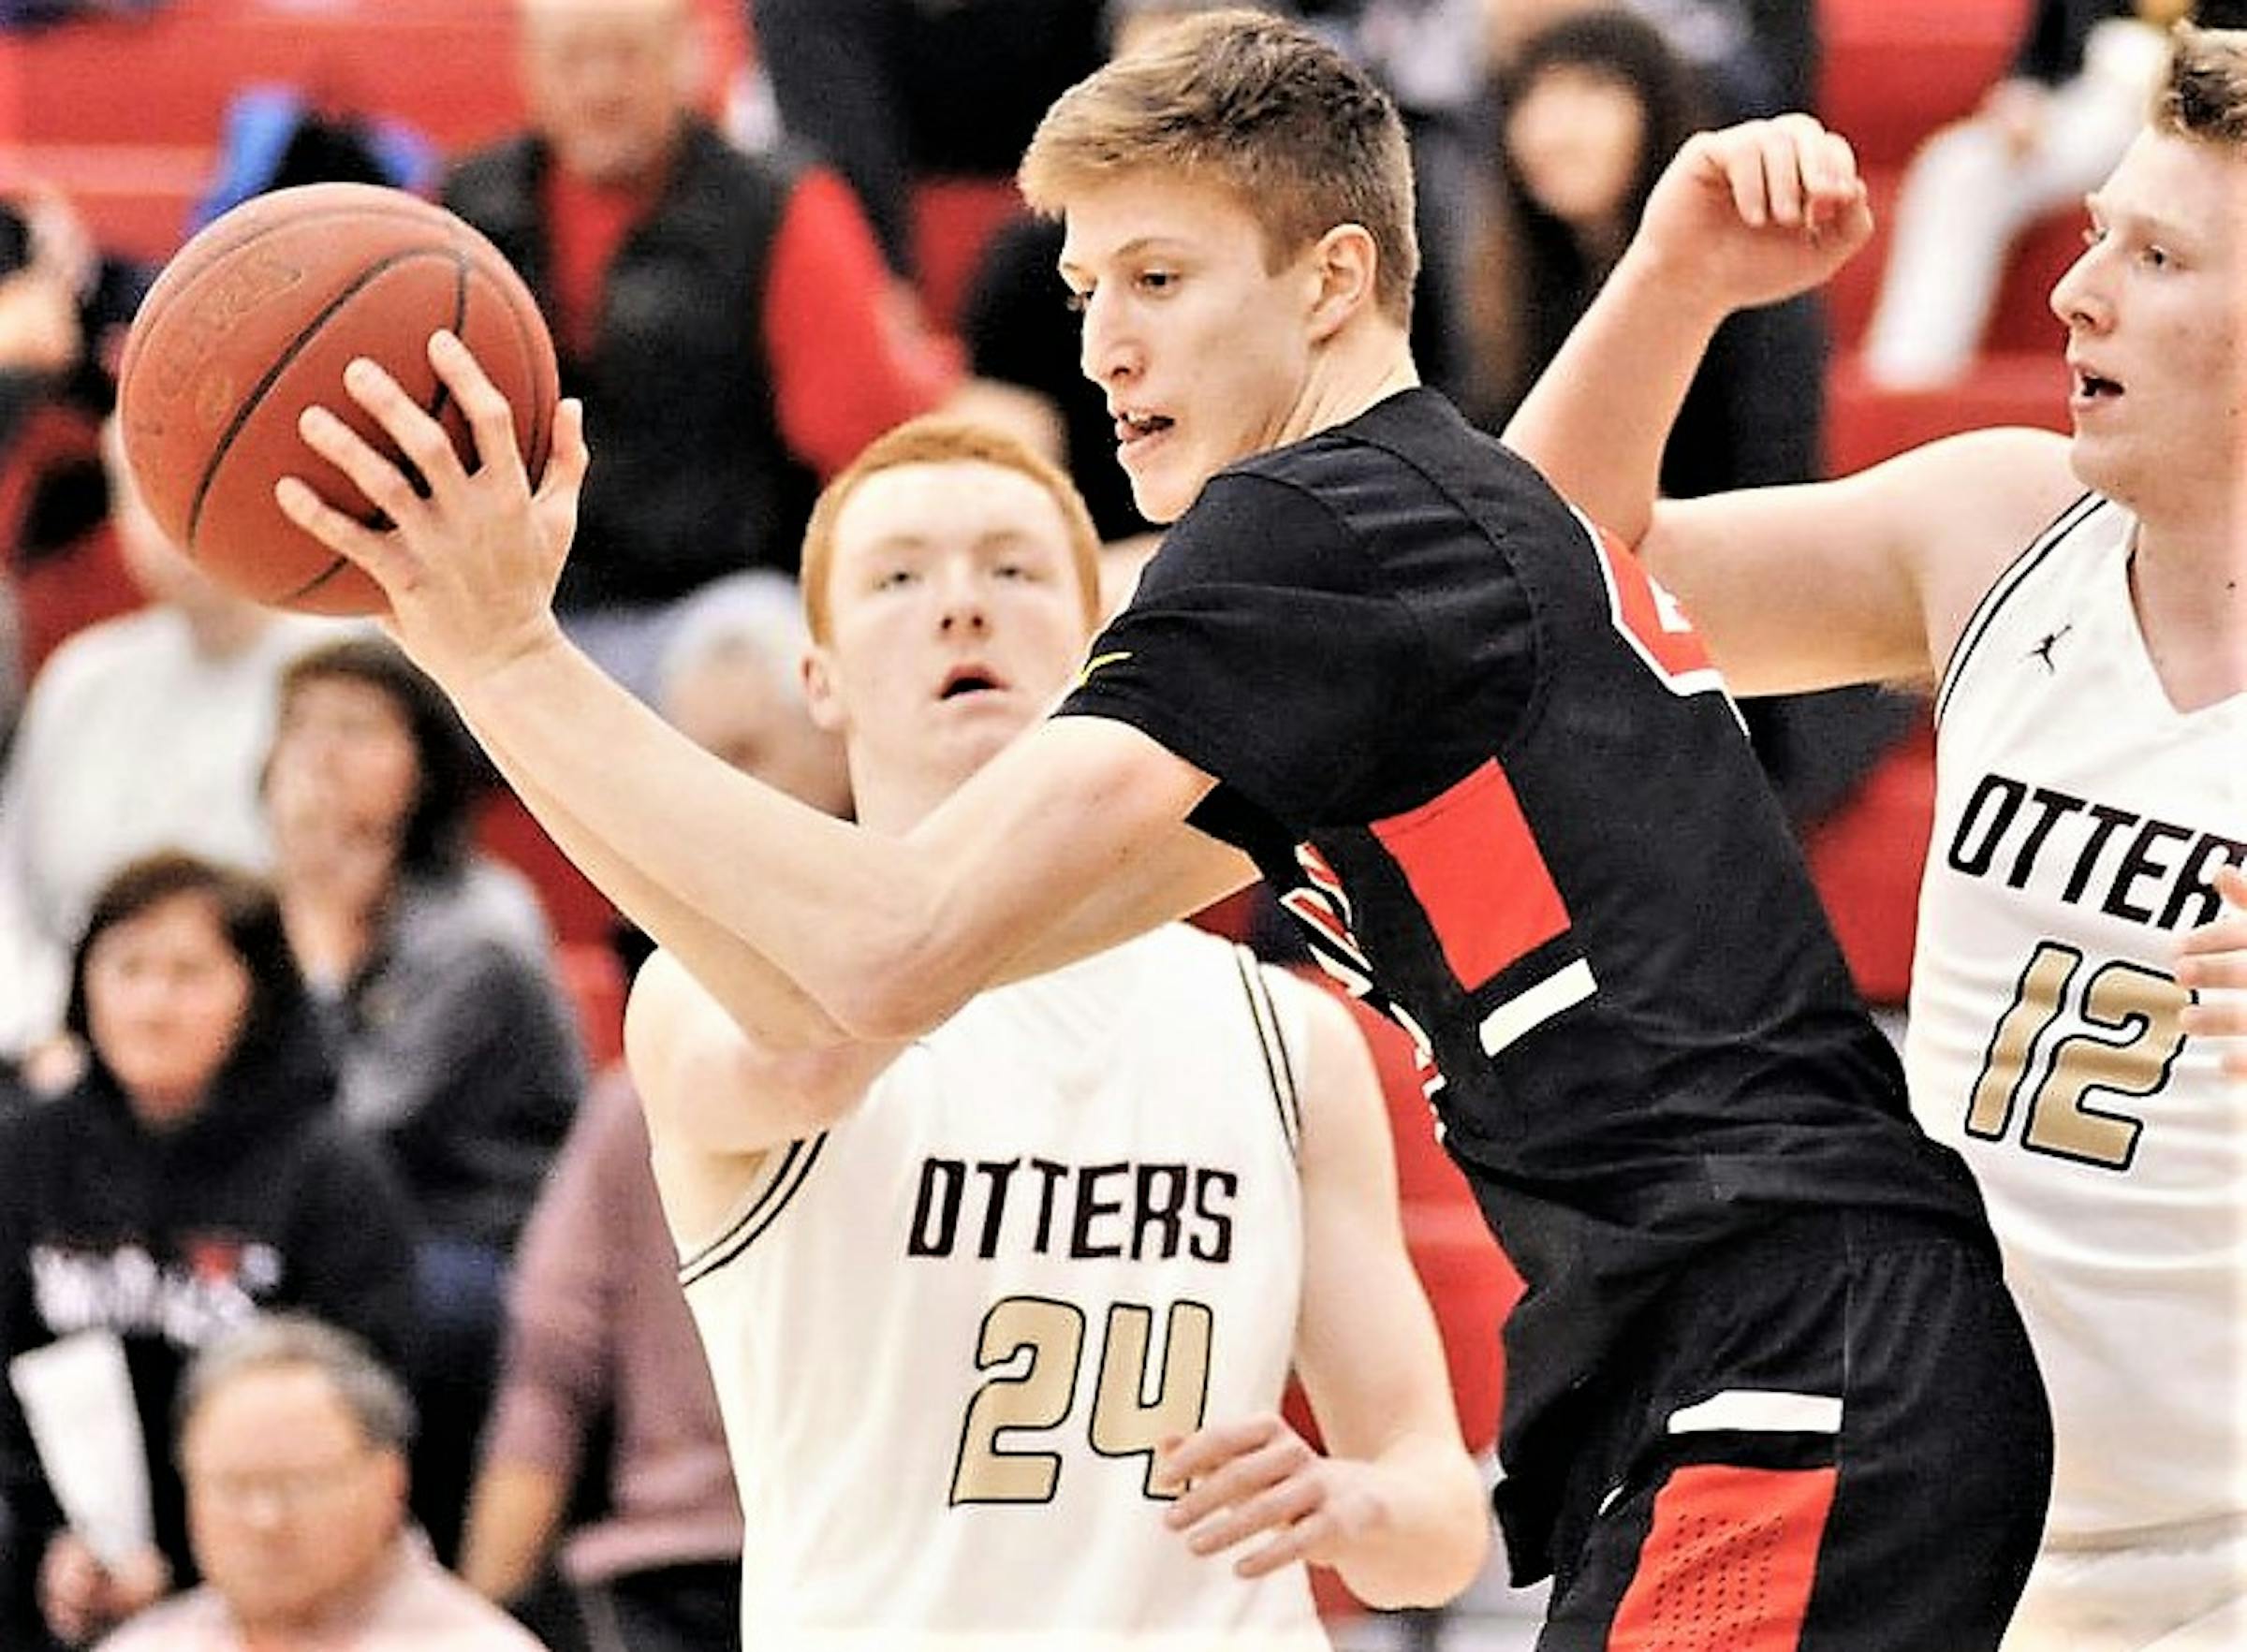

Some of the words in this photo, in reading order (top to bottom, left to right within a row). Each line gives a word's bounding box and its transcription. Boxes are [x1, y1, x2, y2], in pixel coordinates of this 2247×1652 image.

[1965, 942, 2198, 1171] 12
[907, 1157, 1238, 1264] OTTERS
[948, 1295, 1213, 1508] 24
